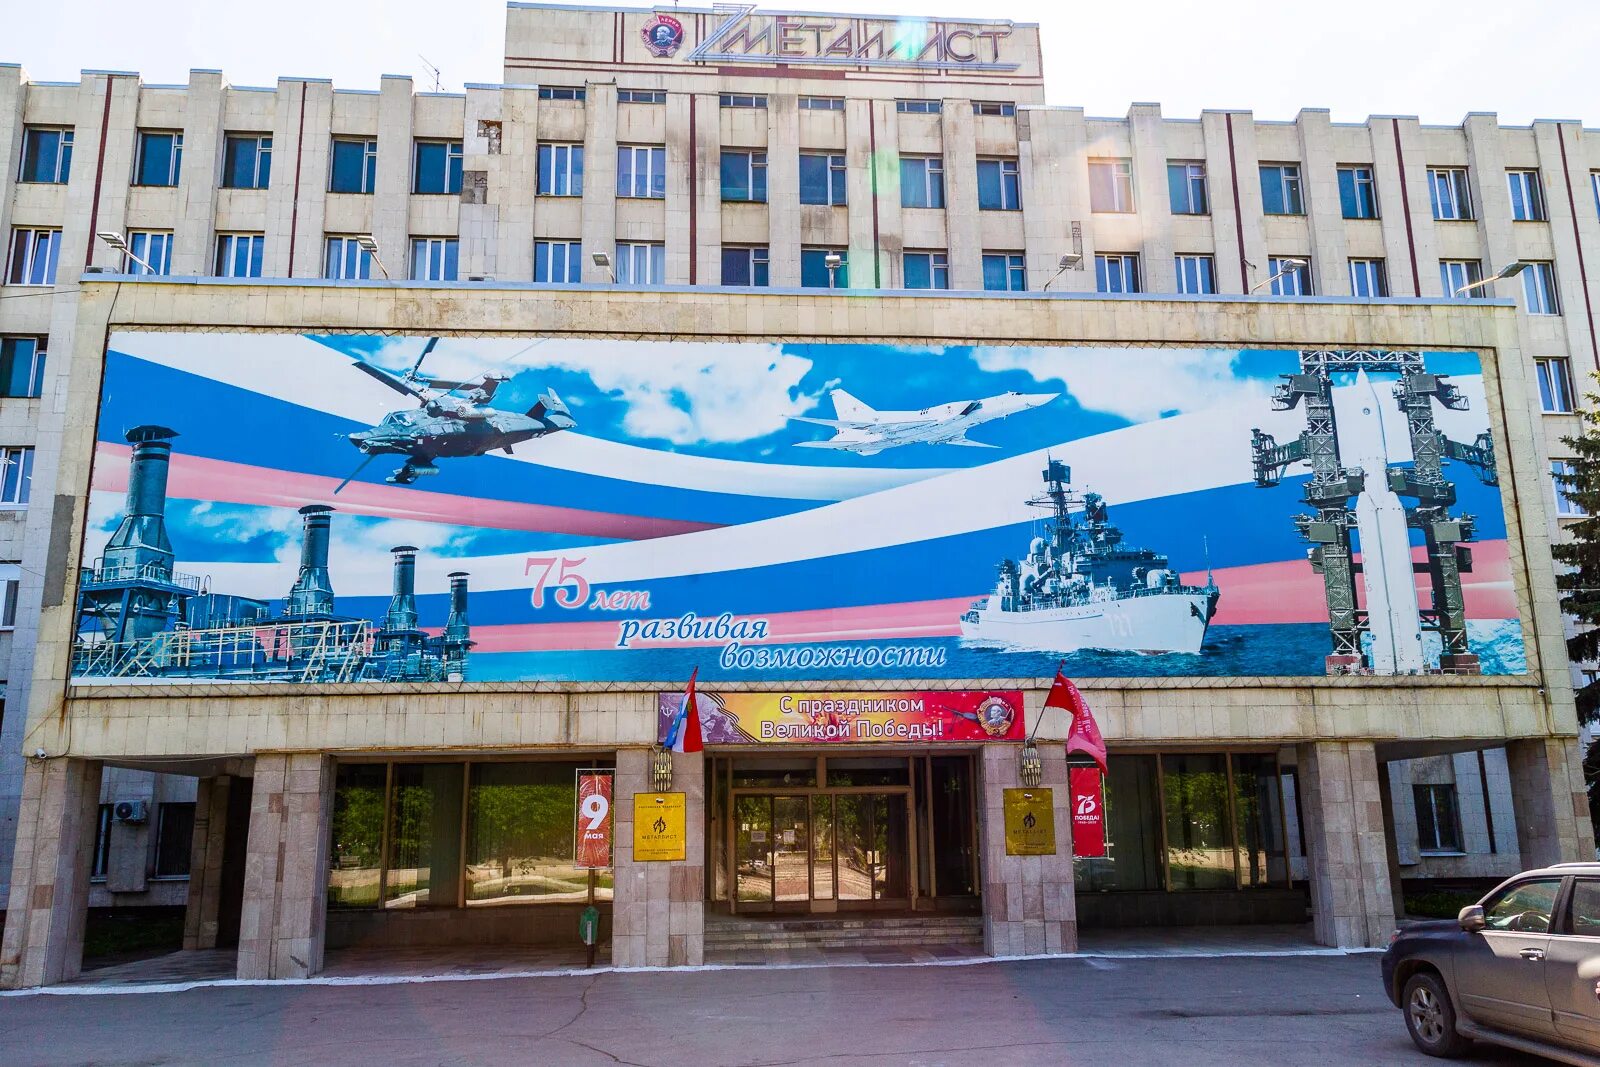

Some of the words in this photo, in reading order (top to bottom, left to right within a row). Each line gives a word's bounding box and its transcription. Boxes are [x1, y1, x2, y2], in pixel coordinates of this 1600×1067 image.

[523, 557, 591, 609] 75
[590, 588, 651, 611] лет
[617, 613, 768, 648] развивая
[720, 641, 946, 670] возможности
[779, 696, 793, 714] С
[797, 695, 924, 714] праздником
[760, 720, 850, 739] Великой
[856, 720, 944, 739] Победы!
[581, 794, 609, 830] 9
[1077, 794, 1095, 814] 75
[583, 832, 604, 840] мая
